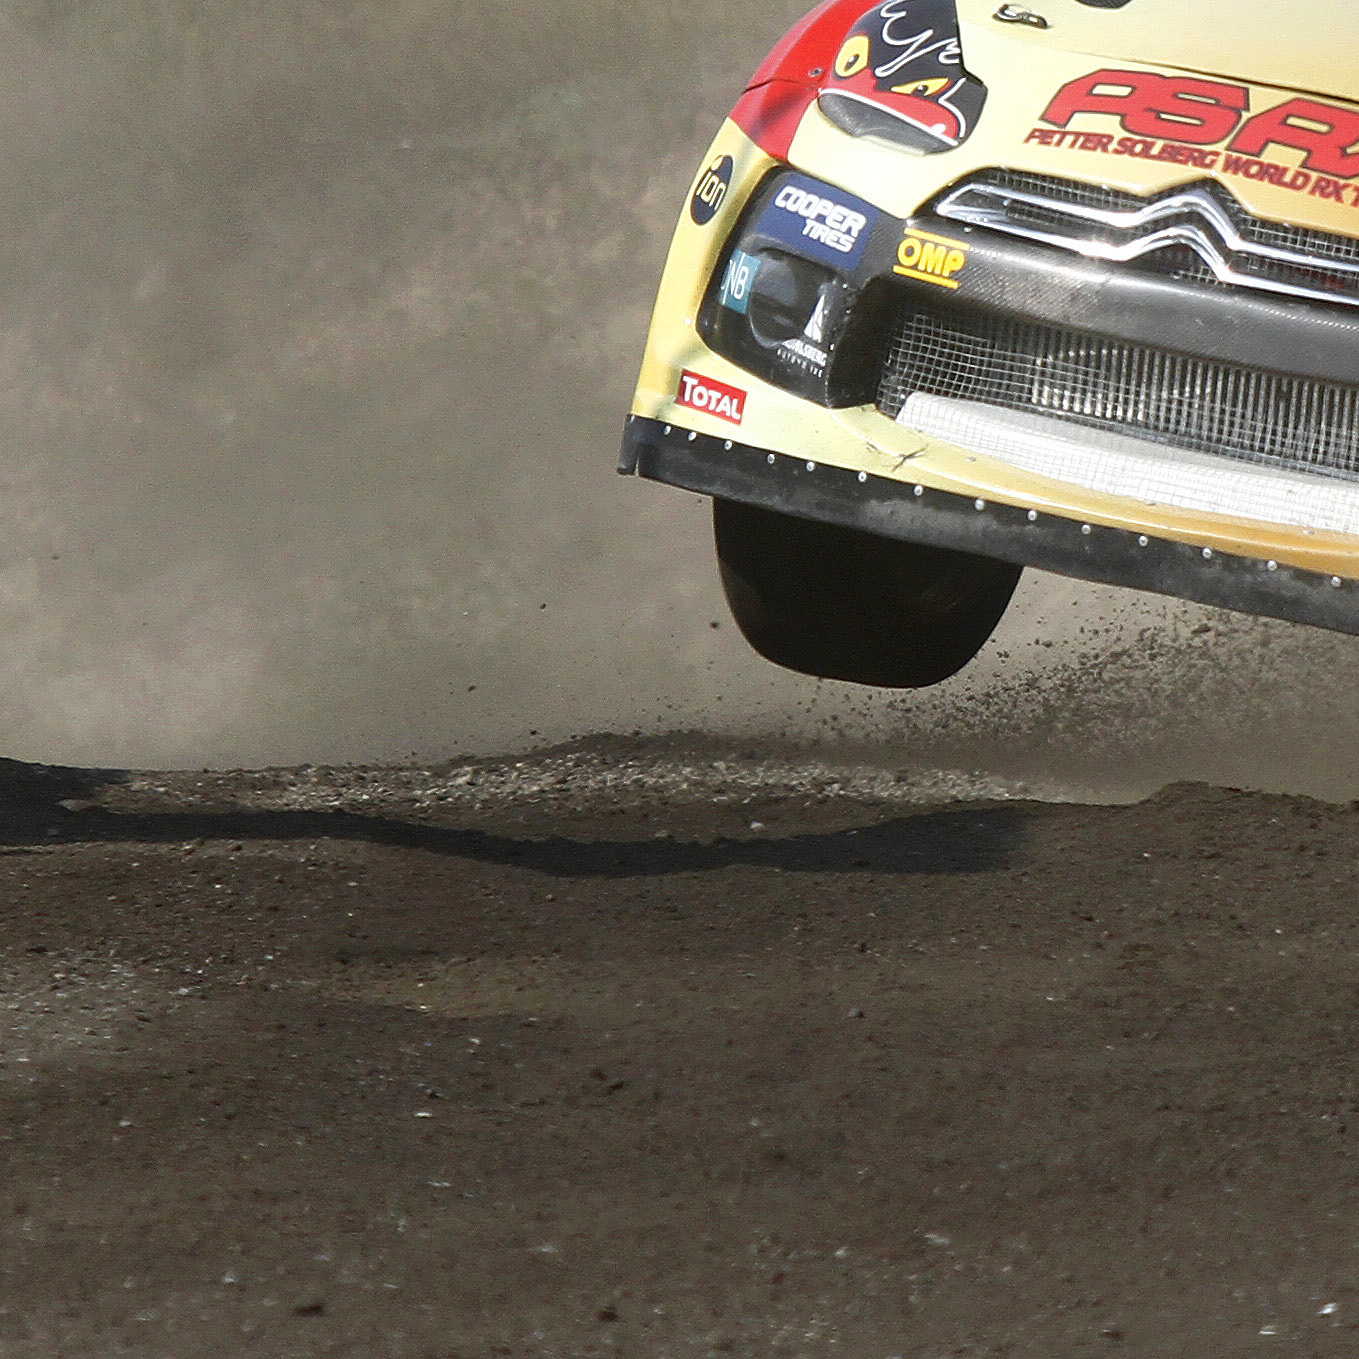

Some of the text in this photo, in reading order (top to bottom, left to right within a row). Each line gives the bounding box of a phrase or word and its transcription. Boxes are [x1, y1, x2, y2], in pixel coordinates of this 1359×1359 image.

[696, 155, 727, 212] ion
[1022, 127, 1112, 153] PETTER
[1113, 134, 1221, 170] SOLBERG
[1222, 151, 1309, 191] WORLD
[1309, 172, 1351, 203] RX
[775, 184, 867, 237] COOPER
[802, 217, 856, 255] TIRES
[897, 237, 965, 279] OMP
[681, 376, 744, 419] TOTAL
